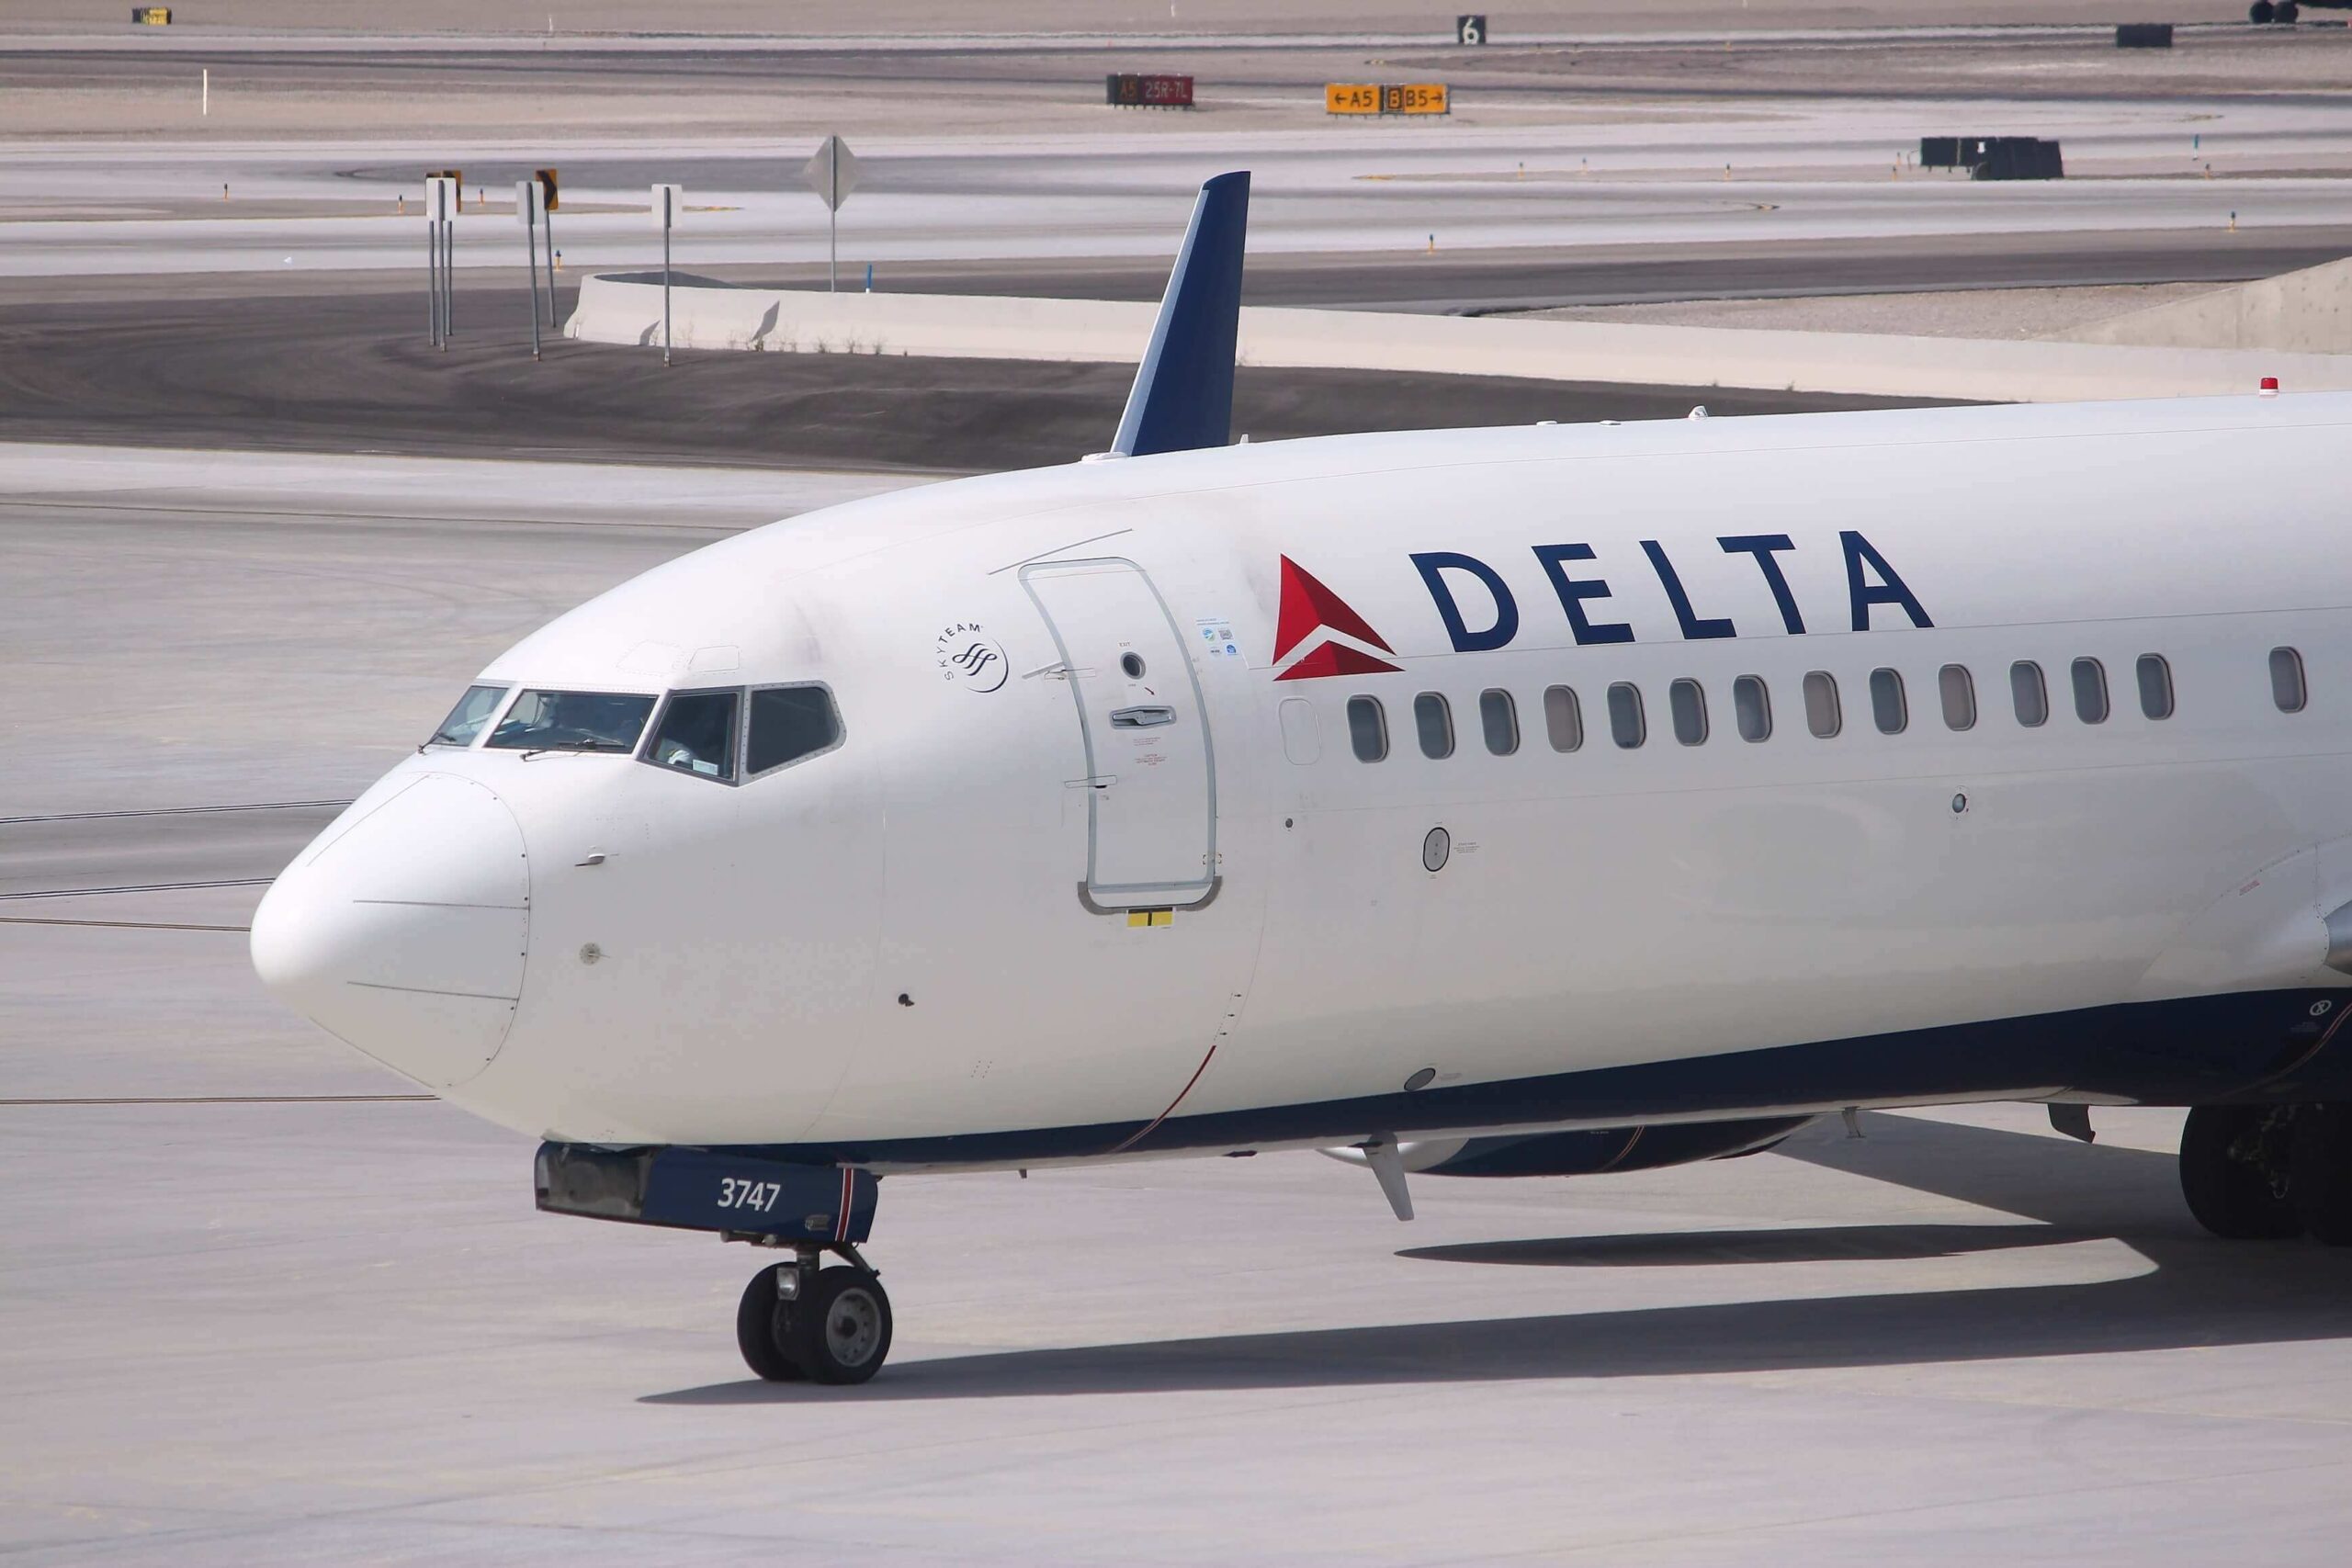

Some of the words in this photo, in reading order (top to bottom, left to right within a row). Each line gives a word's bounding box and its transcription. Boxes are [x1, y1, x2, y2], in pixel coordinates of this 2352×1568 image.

[1463, 17, 1479, 45] 6
[1145, 80, 1188, 98] 25R-7L
[1351, 91, 1374, 107] A5
[1406, 90, 1428, 107] B5
[1408, 531, 1935, 652] DELTA
[936, 623, 981, 681] SKYTEAM
[718, 1178, 781, 1213] 3747
